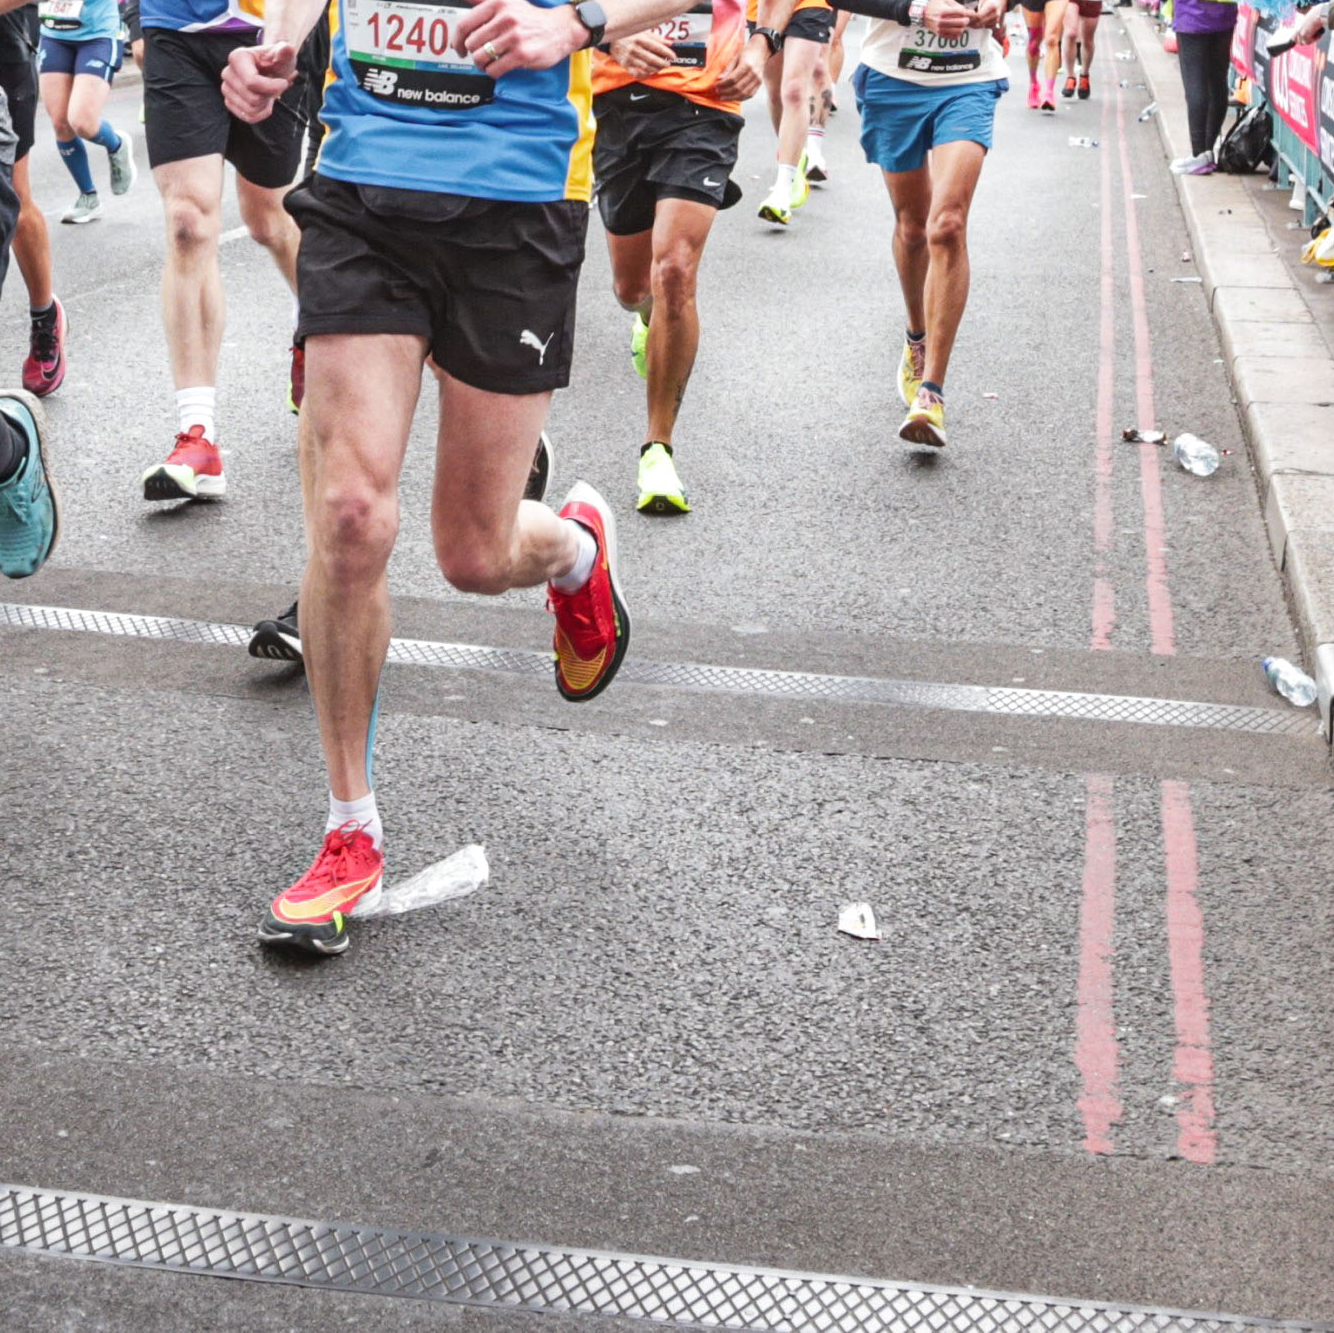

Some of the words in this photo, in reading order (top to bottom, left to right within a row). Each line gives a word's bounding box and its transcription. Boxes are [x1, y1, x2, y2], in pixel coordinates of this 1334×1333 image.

[367, 11, 453, 56] 1240
[397, 87, 423, 101] new
[424, 87, 481, 104] balance
